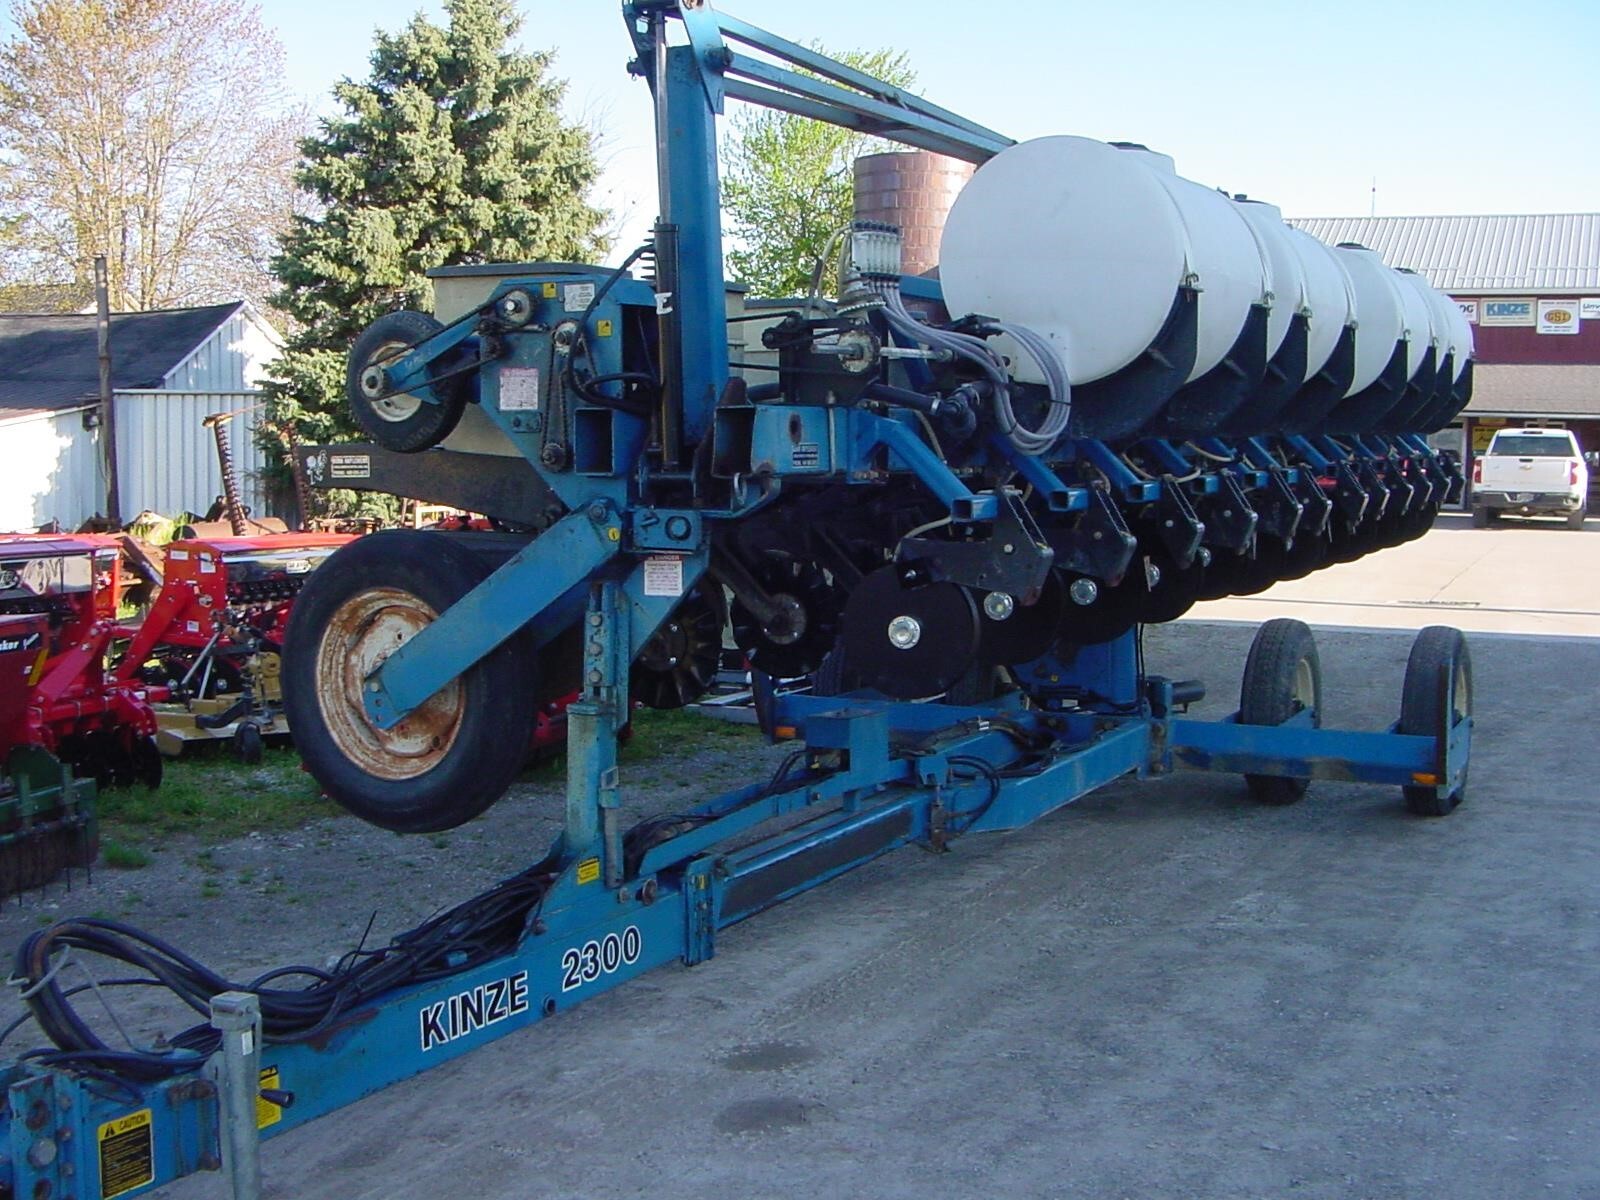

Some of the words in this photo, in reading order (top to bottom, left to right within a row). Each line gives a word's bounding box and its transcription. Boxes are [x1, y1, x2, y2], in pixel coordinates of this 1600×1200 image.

[1486, 303, 1530, 316] KINZE
[420, 970, 529, 1051] KINZE
[562, 925, 642, 992] 2300
[119, 1113, 147, 1130] CAUTION
